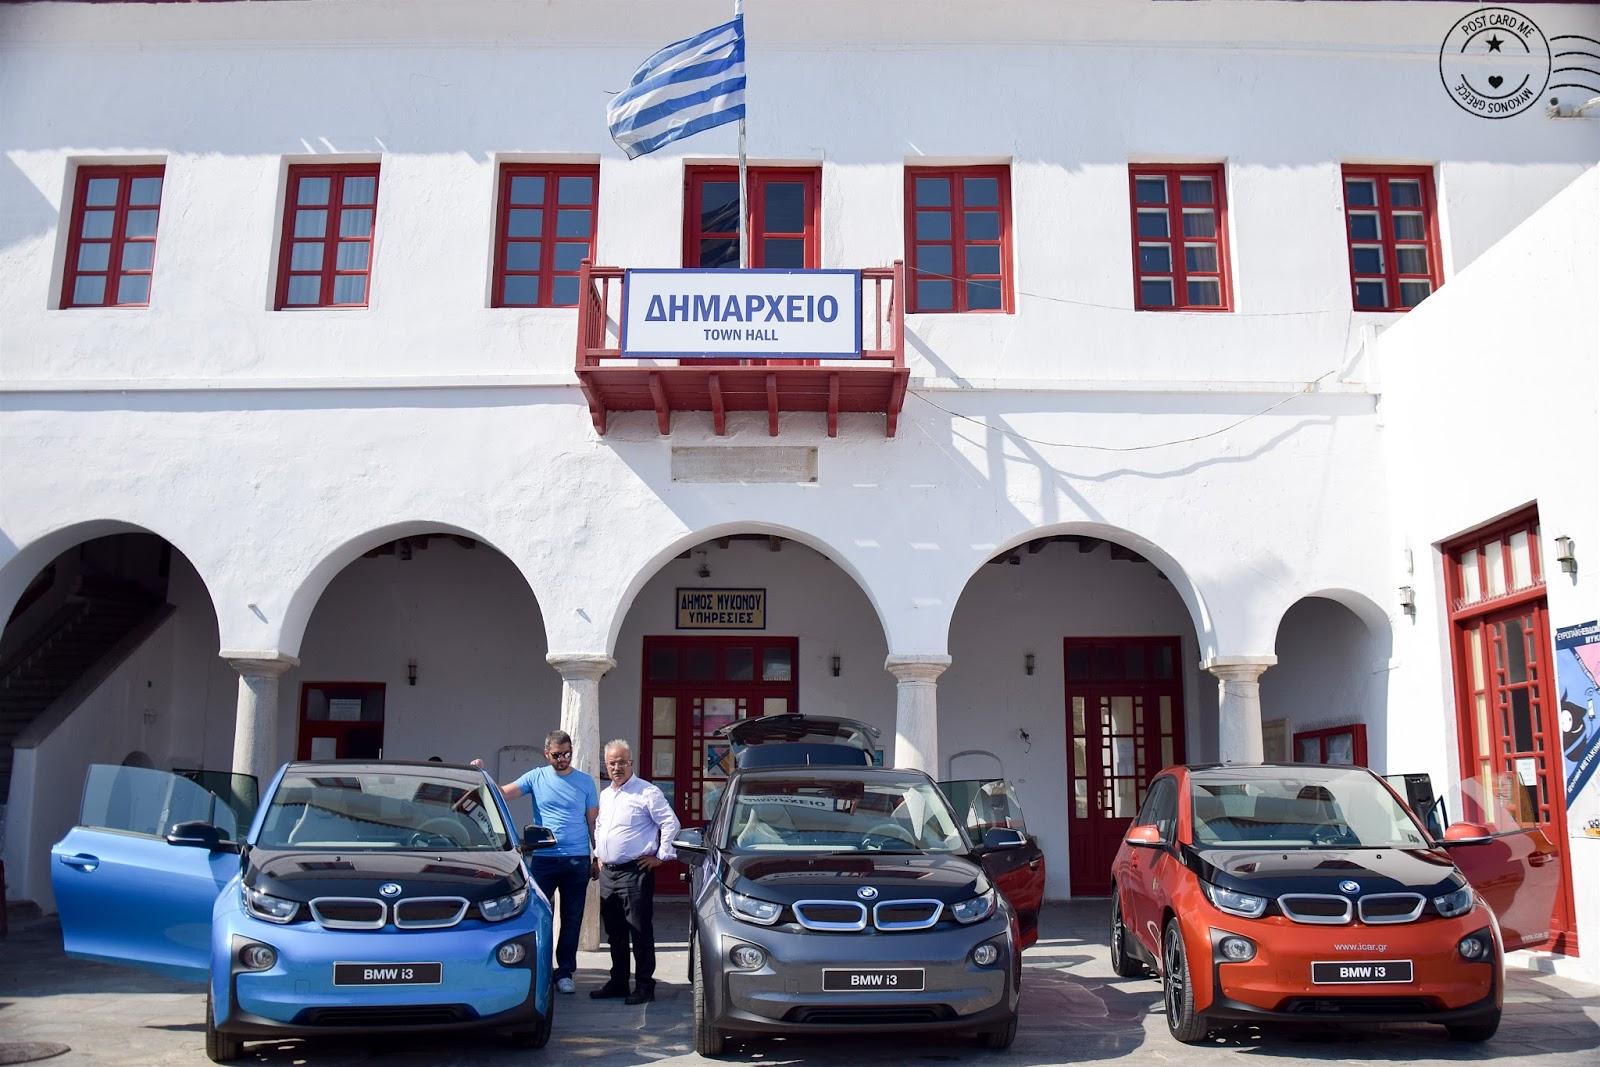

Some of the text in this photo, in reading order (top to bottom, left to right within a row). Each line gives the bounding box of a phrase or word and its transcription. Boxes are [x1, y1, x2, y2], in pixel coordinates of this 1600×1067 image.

[644, 294, 839, 323] ΔΗΜΑΡΧΕΙΟ
[703, 328, 779, 341] TOWN HALL
[681, 594, 762, 611] ΔΗΜΟΣ ΜΥΚΟΝΟΥ
[688, 611, 754, 624] ΥΠΗΡΕΣΙΕΣ
[1333, 942, 1388, 953] www.icar.gr
[363, 968, 414, 980] BMW i3
[1339, 966, 1386, 978] BMW i3
[850, 974, 898, 986] BMW i3
